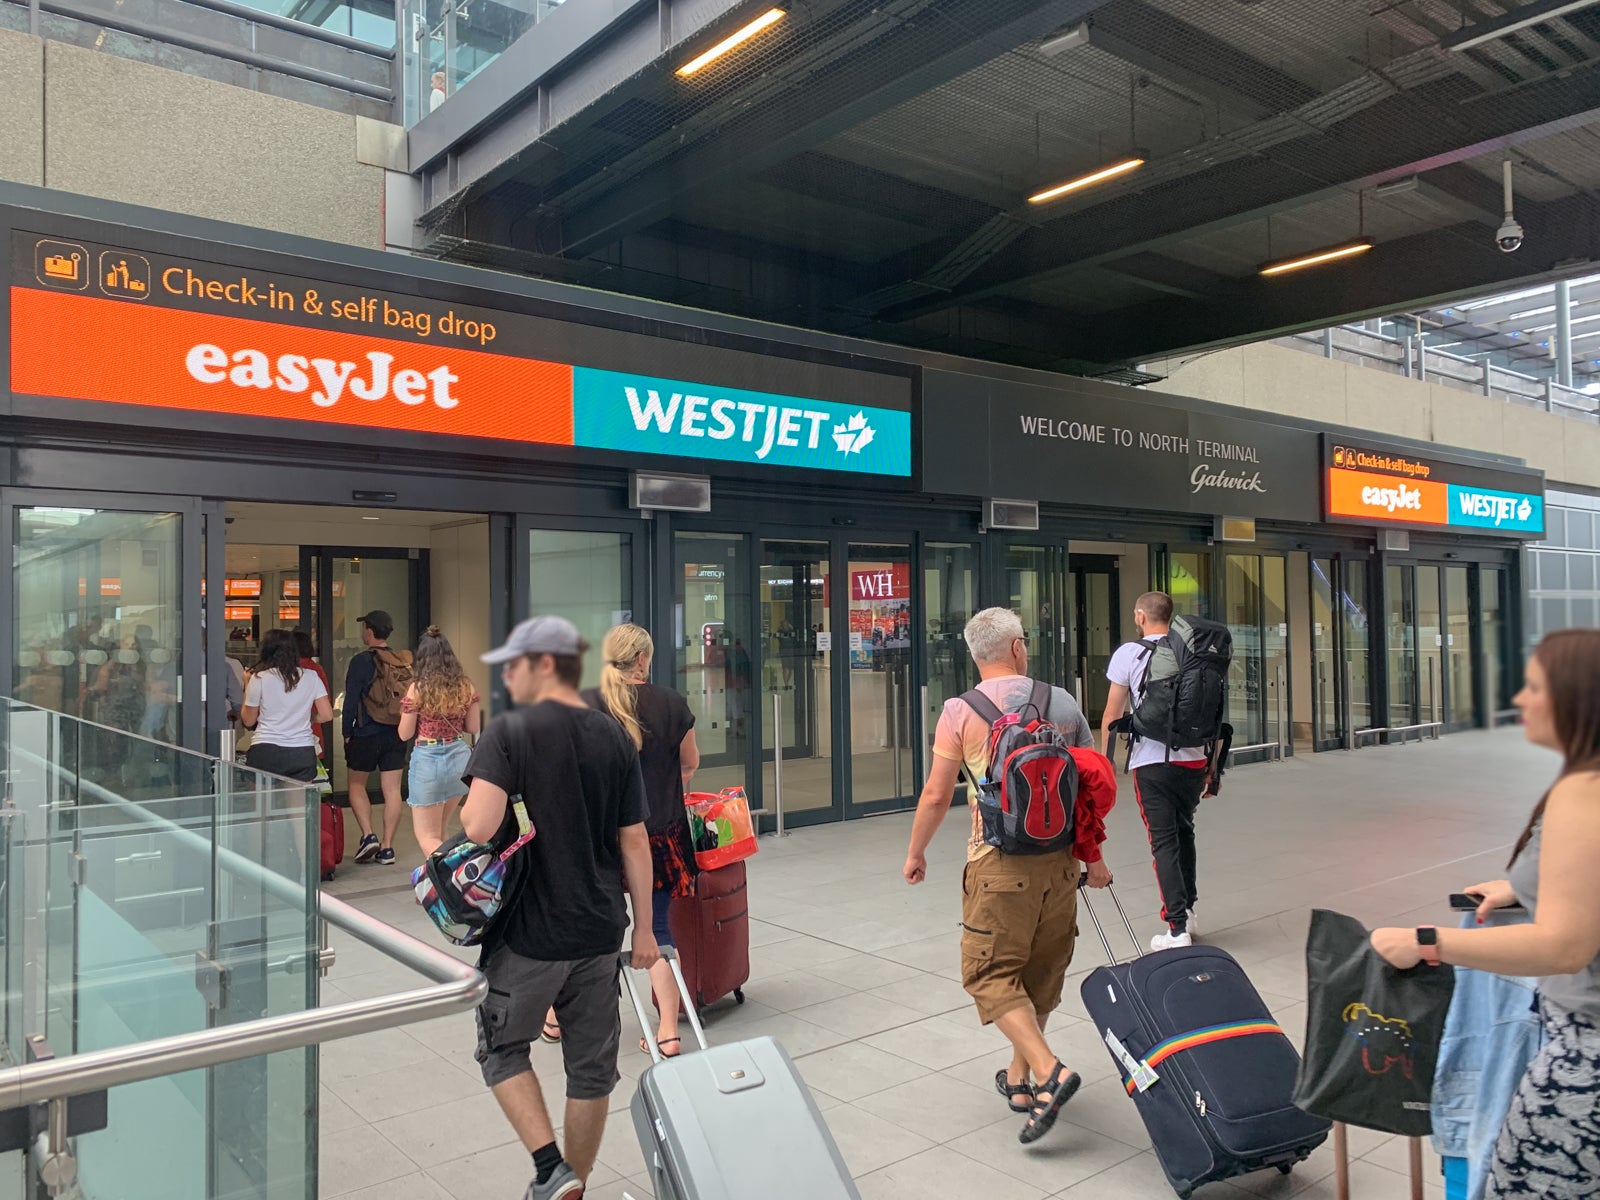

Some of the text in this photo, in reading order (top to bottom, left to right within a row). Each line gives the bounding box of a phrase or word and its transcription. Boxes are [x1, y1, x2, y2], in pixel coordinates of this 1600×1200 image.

[161, 267, 497, 345] Check-in & self bag drop
[185, 343, 459, 410] easyJet
[623, 386, 830, 460] WESTJET
[1020, 415, 1260, 464] WELCOME TO NORTH TERMINAL
[1190, 464, 1267, 494] Gatwick
[1357, 453, 1385, 468] Check-in
[1391, 458, 1403, 471] self
[1403, 459, 1415, 476] bag
[1414, 461, 1430, 478] drop
[1361, 483, 1421, 512] easyJet
[1459, 492, 1518, 526] WESTJET
[857, 573, 893, 597] WH
